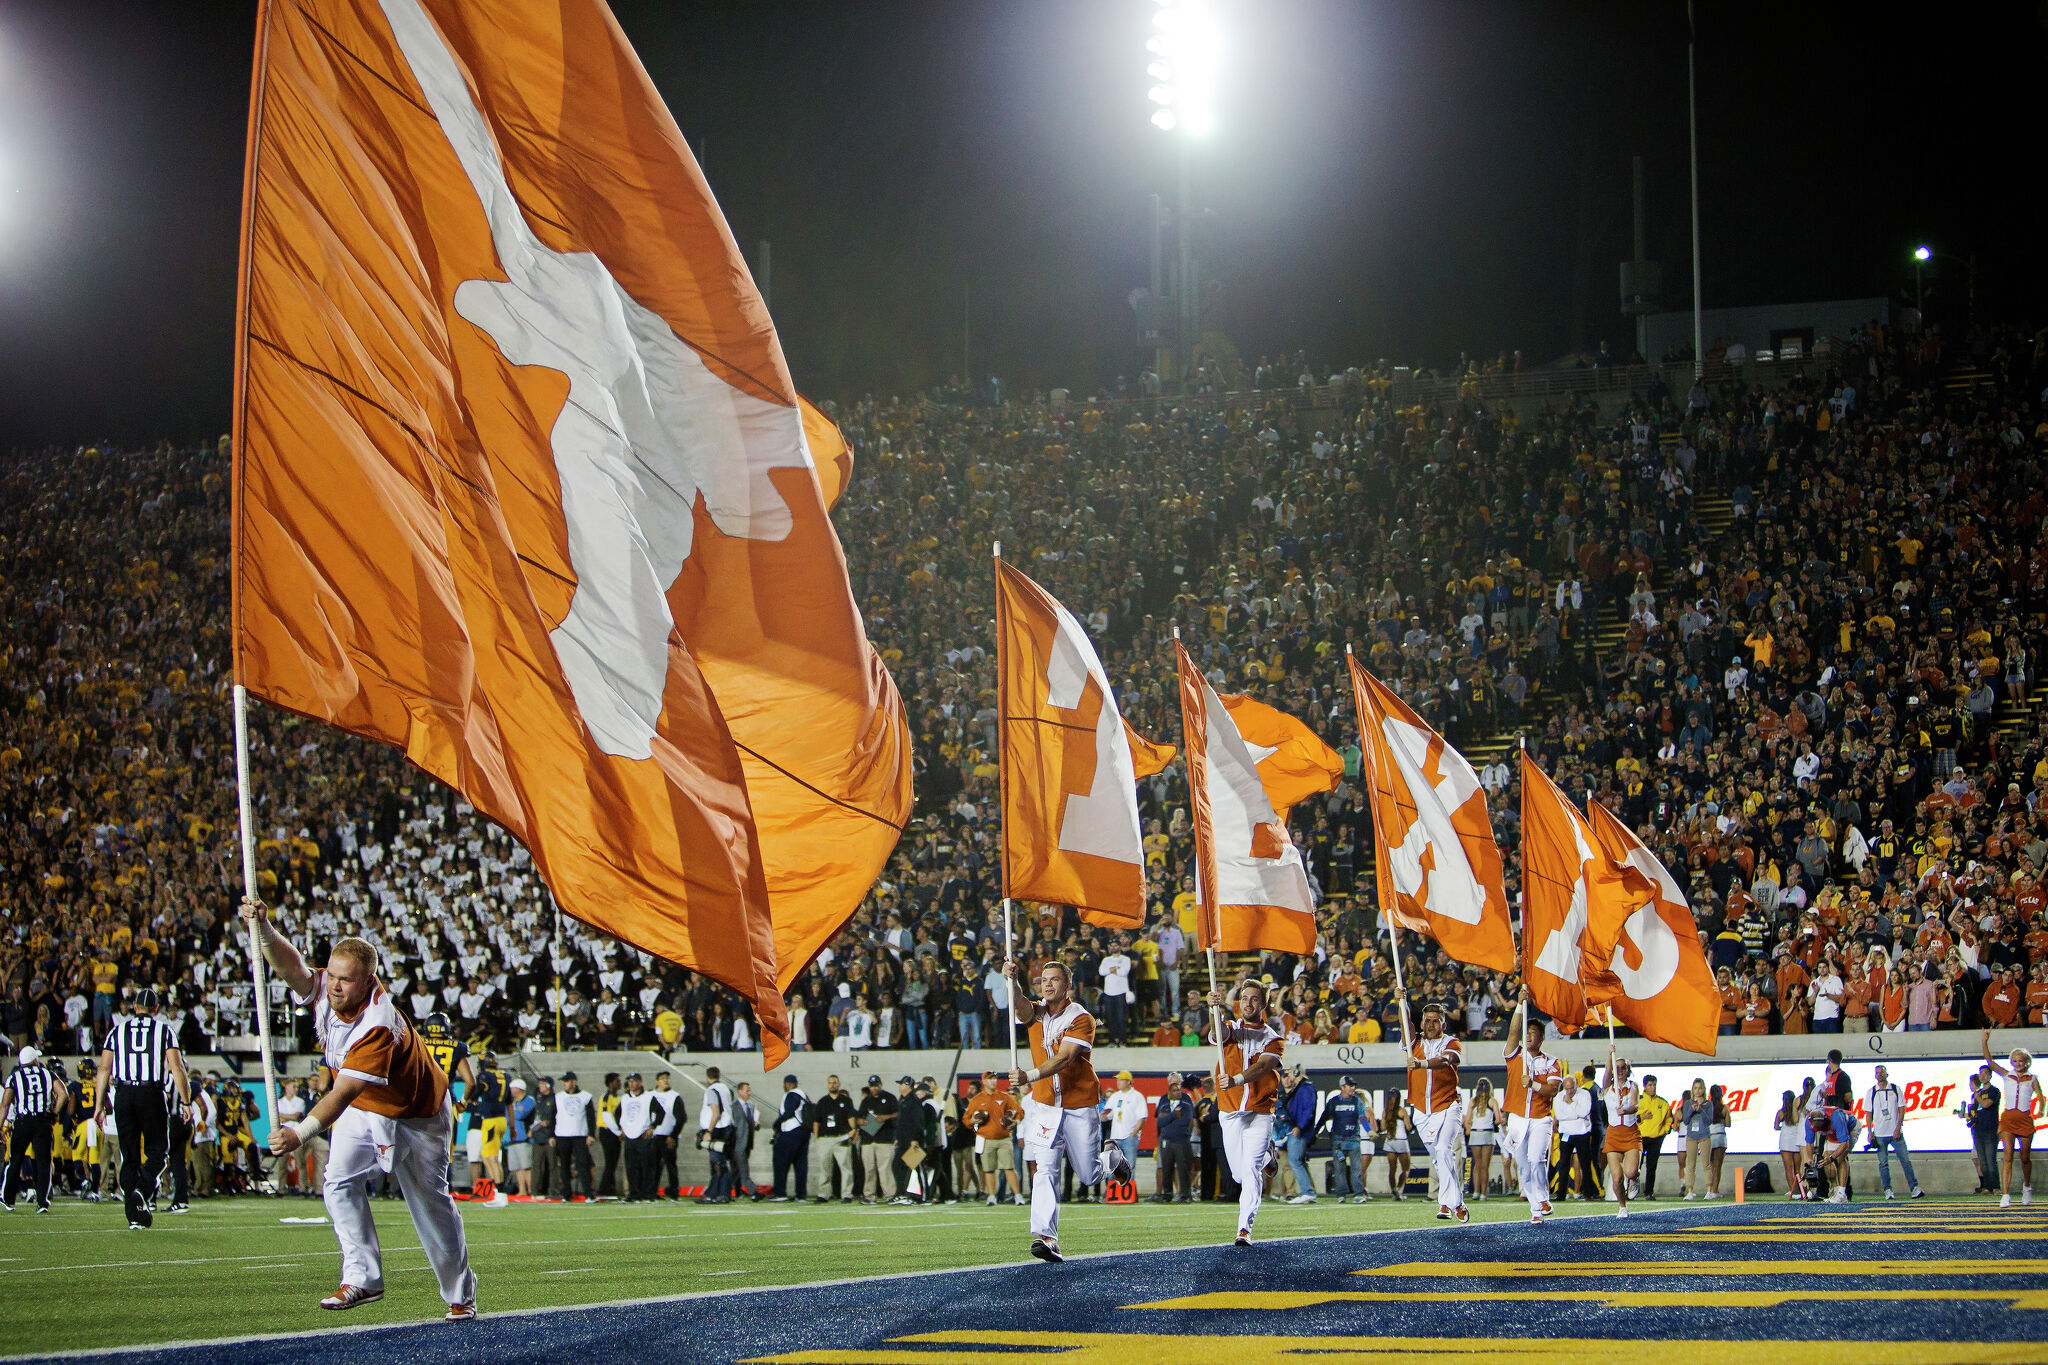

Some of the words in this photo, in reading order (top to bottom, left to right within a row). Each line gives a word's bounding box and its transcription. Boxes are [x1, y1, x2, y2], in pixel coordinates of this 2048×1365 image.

[1473, 689, 1484, 701] 21
[1879, 841, 1894, 858] 10
[1913, 840, 1928, 855] Cal
[2020, 896, 2040, 905] TEXAS
[131, 1028, 149, 1052] U
[1868, 1035, 1883, 1054] Q
[850, 1055, 860, 1068] R
[1337, 1046, 1365, 1064] QQ
[28, 1074, 43, 1094] R
[497, 1079, 507, 1102] 7
[81, 1087, 95, 1109] 3
[474, 1180, 494, 1197] 20
[1108, 1185, 1134, 1201] 10
